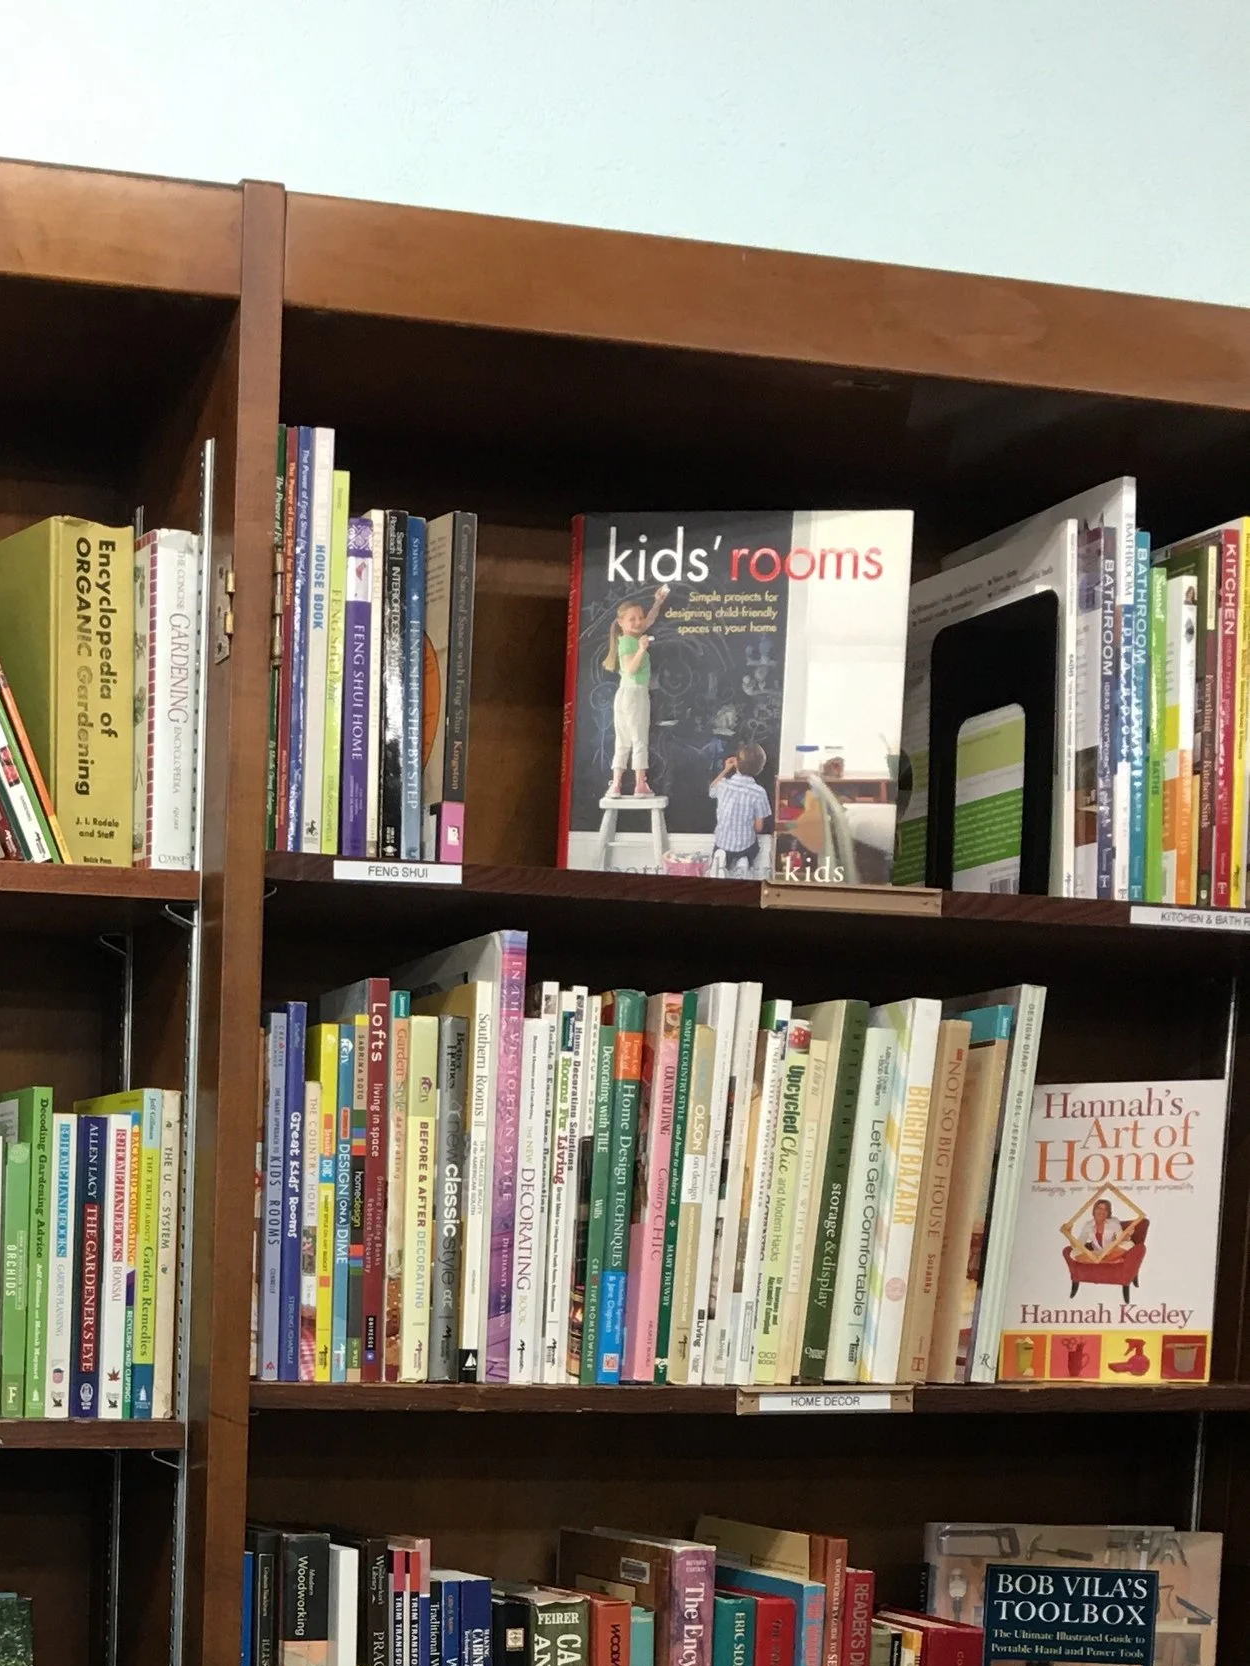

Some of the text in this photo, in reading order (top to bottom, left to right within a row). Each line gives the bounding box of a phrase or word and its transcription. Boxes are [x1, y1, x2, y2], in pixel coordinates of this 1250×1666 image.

[607, 527, 883, 584] kids' rooms
[688, 591, 778, 605] Simple projects for
[665, 606, 778, 622] designing child-friendly
[99, 539, 118, 739] Encyclopedia of
[677, 624, 710, 636] spaces
[724, 625, 747, 637] your
[750, 623, 777, 634] home
[75, 537, 91, 796] ORGANIC Gardening
[79, 829, 116, 840] and Staff
[367, 865, 429, 878] FENG SHUI
[784, 856, 845, 882] kids
[1161, 912, 1203, 924] KITCHEN
[1215, 915, 1241, 924] BATH
[371, 1004, 386, 1062] Lofts
[1043, 1088, 1184, 1120] Hannah's
[1081, 1111, 1199, 1150] Art of
[1032, 1139, 1195, 1183] Home
[1020, 1303, 1195, 1329] Hannah Keeley
[791, 1396, 860, 1407] HOME DECOR
[997, 1574, 1148, 1600] BOB VILA'S
[538, 1612, 579, 1625] FEIRER
[994, 1600, 1146, 1626] TOOLBOX
[993, 1630, 1145, 1644] The Ultimate Illustrated Guide to
[991, 1643, 1144, 1658] Portable Hand and Power Tools
